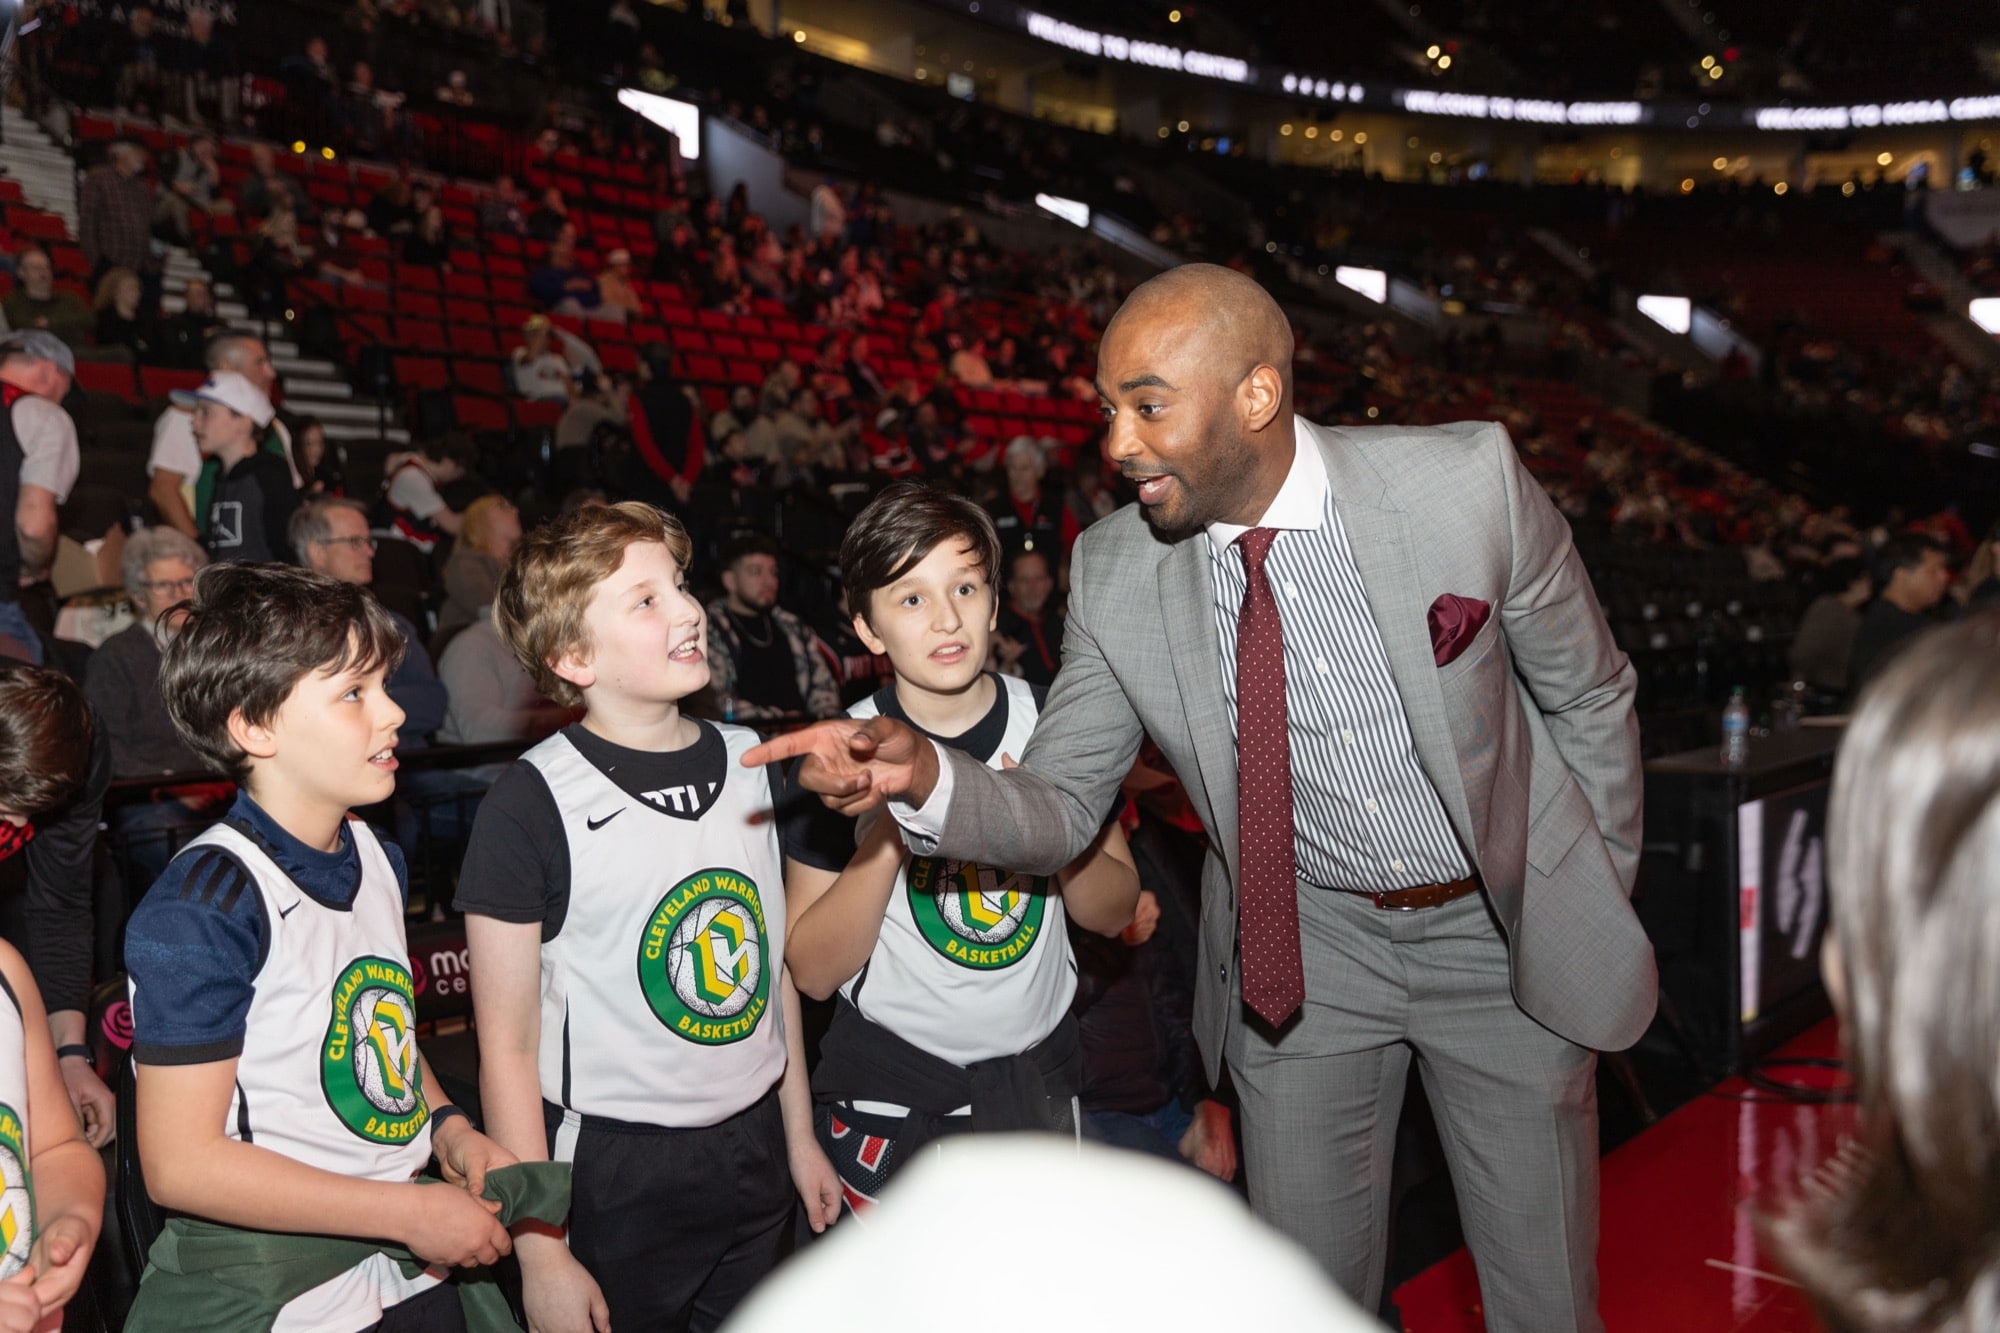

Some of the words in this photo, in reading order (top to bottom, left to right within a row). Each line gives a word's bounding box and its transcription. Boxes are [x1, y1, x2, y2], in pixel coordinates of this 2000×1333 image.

[645, 878, 711, 960] CLEVELAND
[715, 876, 766, 935] WARRIORS
[946, 924, 1035, 963] BASKETBALL
[328, 968, 364, 1061] CLEVELAND
[678, 997, 765, 1039] BASKETBALL
